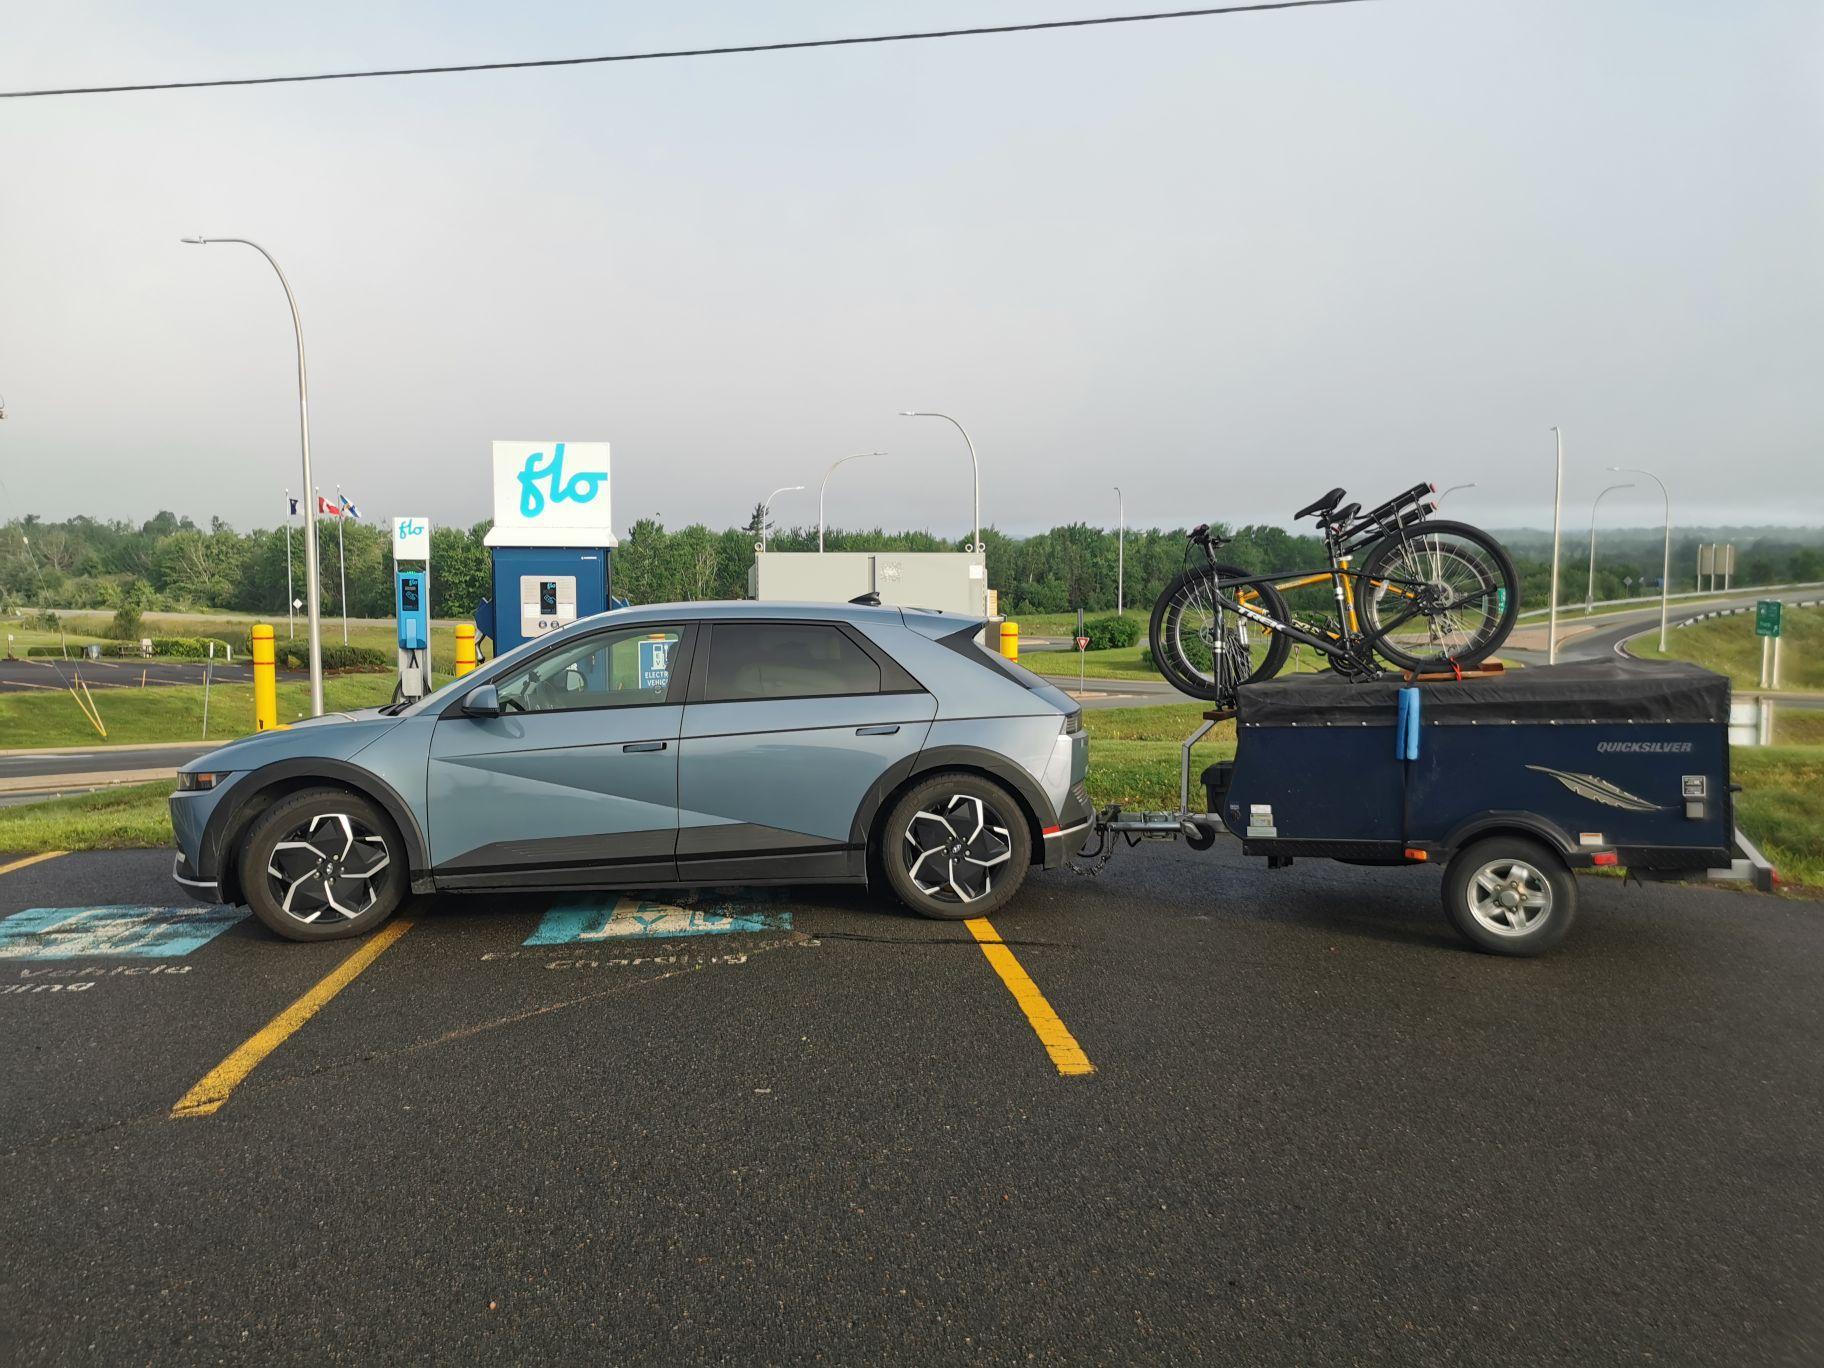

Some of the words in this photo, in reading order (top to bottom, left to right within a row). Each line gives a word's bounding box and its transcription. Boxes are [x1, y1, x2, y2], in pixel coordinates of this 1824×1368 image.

[517, 443, 608, 518] flo
[399, 519, 424, 540] flo
[1237, 605, 1287, 632] TREK
[645, 671, 669, 679] ELECTR
[647, 678, 668, 686] VEHIC
[1596, 741, 1693, 753] QUICKSILVER
